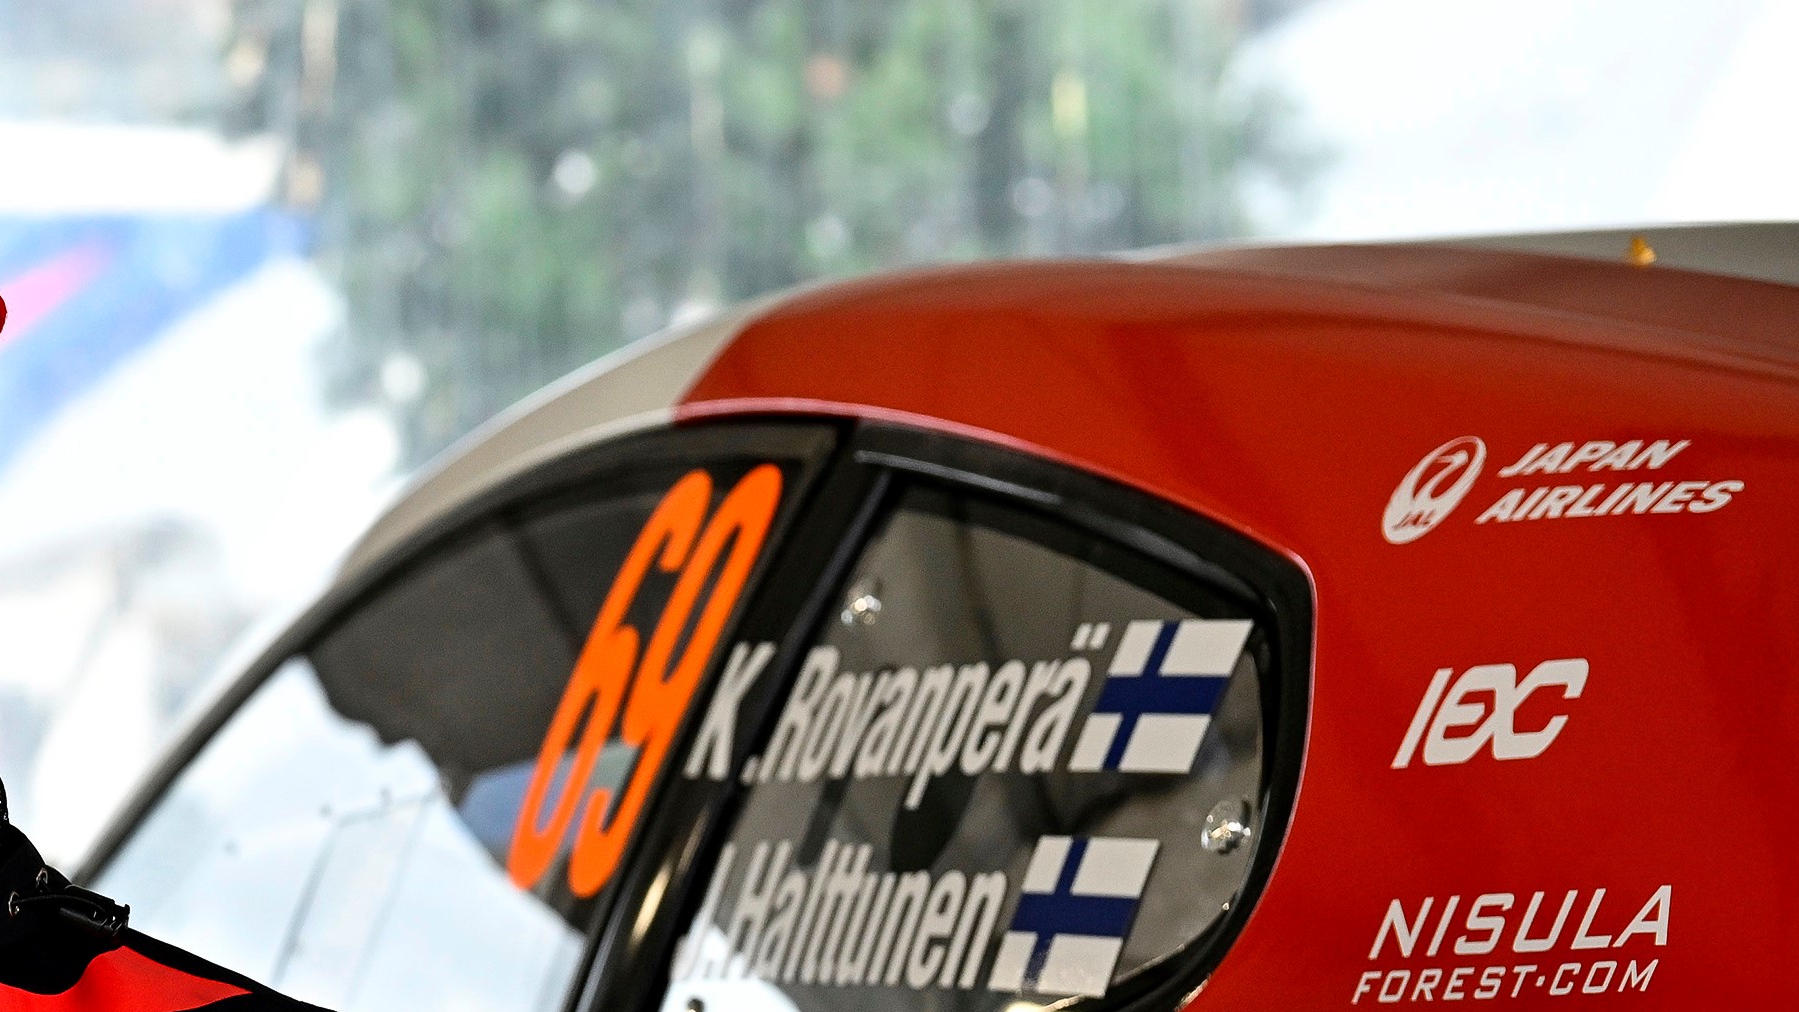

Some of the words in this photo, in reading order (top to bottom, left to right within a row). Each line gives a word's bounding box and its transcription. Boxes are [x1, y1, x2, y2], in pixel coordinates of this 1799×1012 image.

[1498, 439, 1692, 478] JAPAN
[1474, 480, 1745, 525] AIRLINES
[507, 464, 784, 898] 69
[1368, 884, 1673, 960] NISULA
